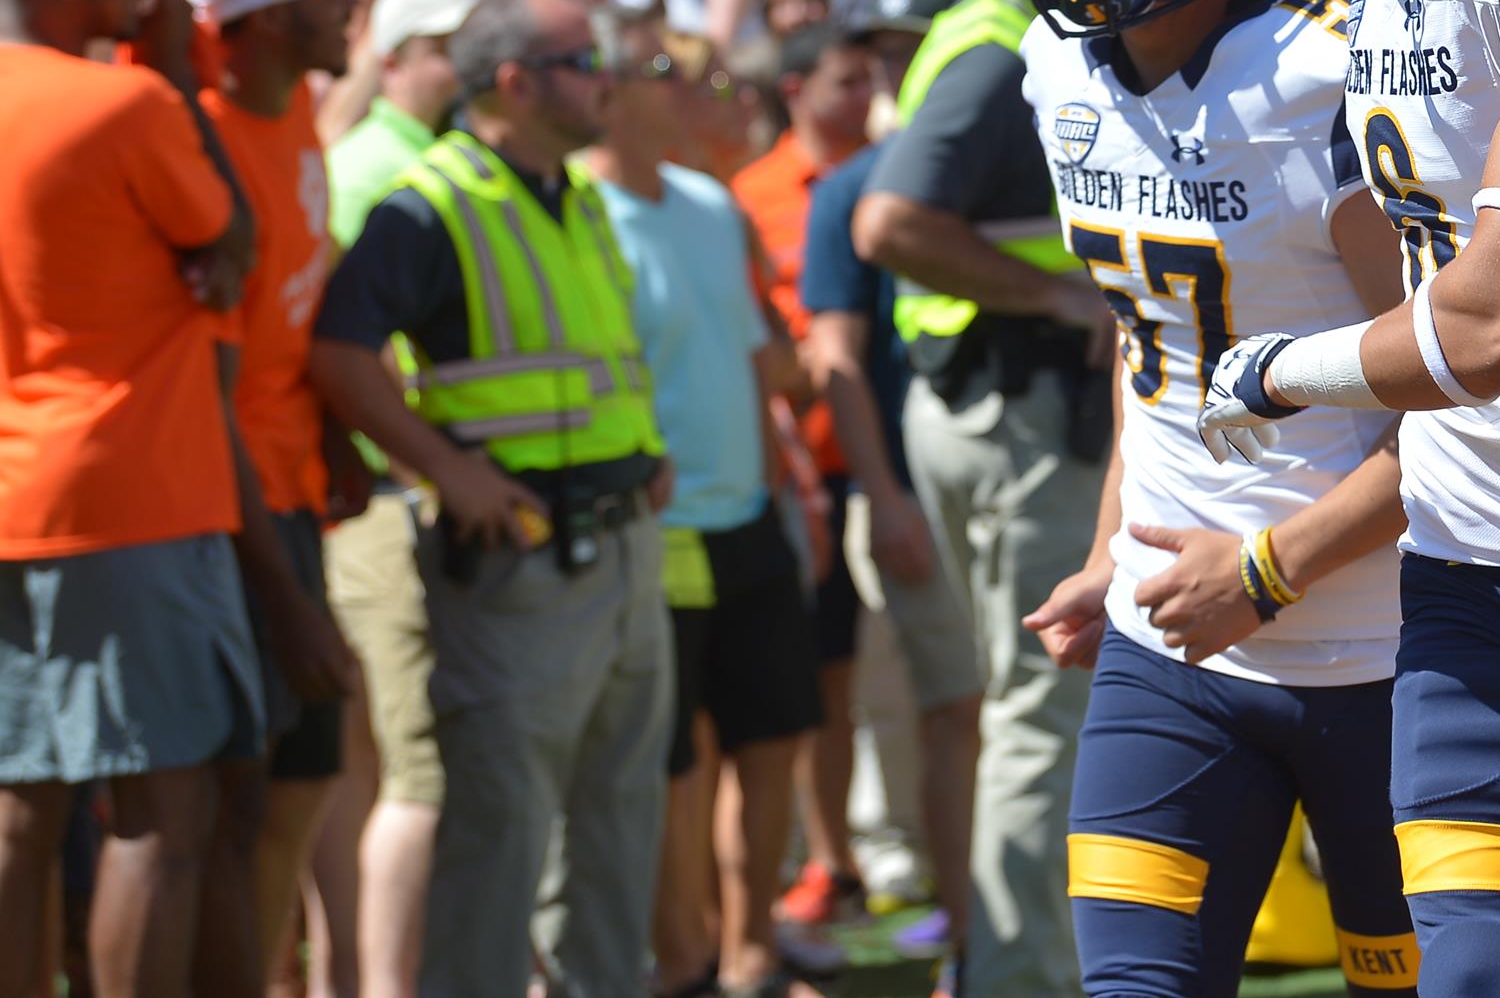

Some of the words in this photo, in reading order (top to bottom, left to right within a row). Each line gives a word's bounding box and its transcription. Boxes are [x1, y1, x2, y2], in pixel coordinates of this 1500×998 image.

[1345, 49, 1372, 95] LDEN
[1380, 46, 1458, 96] FLASHES
[1138, 174, 1249, 223] FLASHES
[1069, 218, 1236, 408] 57
[1347, 946, 1407, 975] KENT
